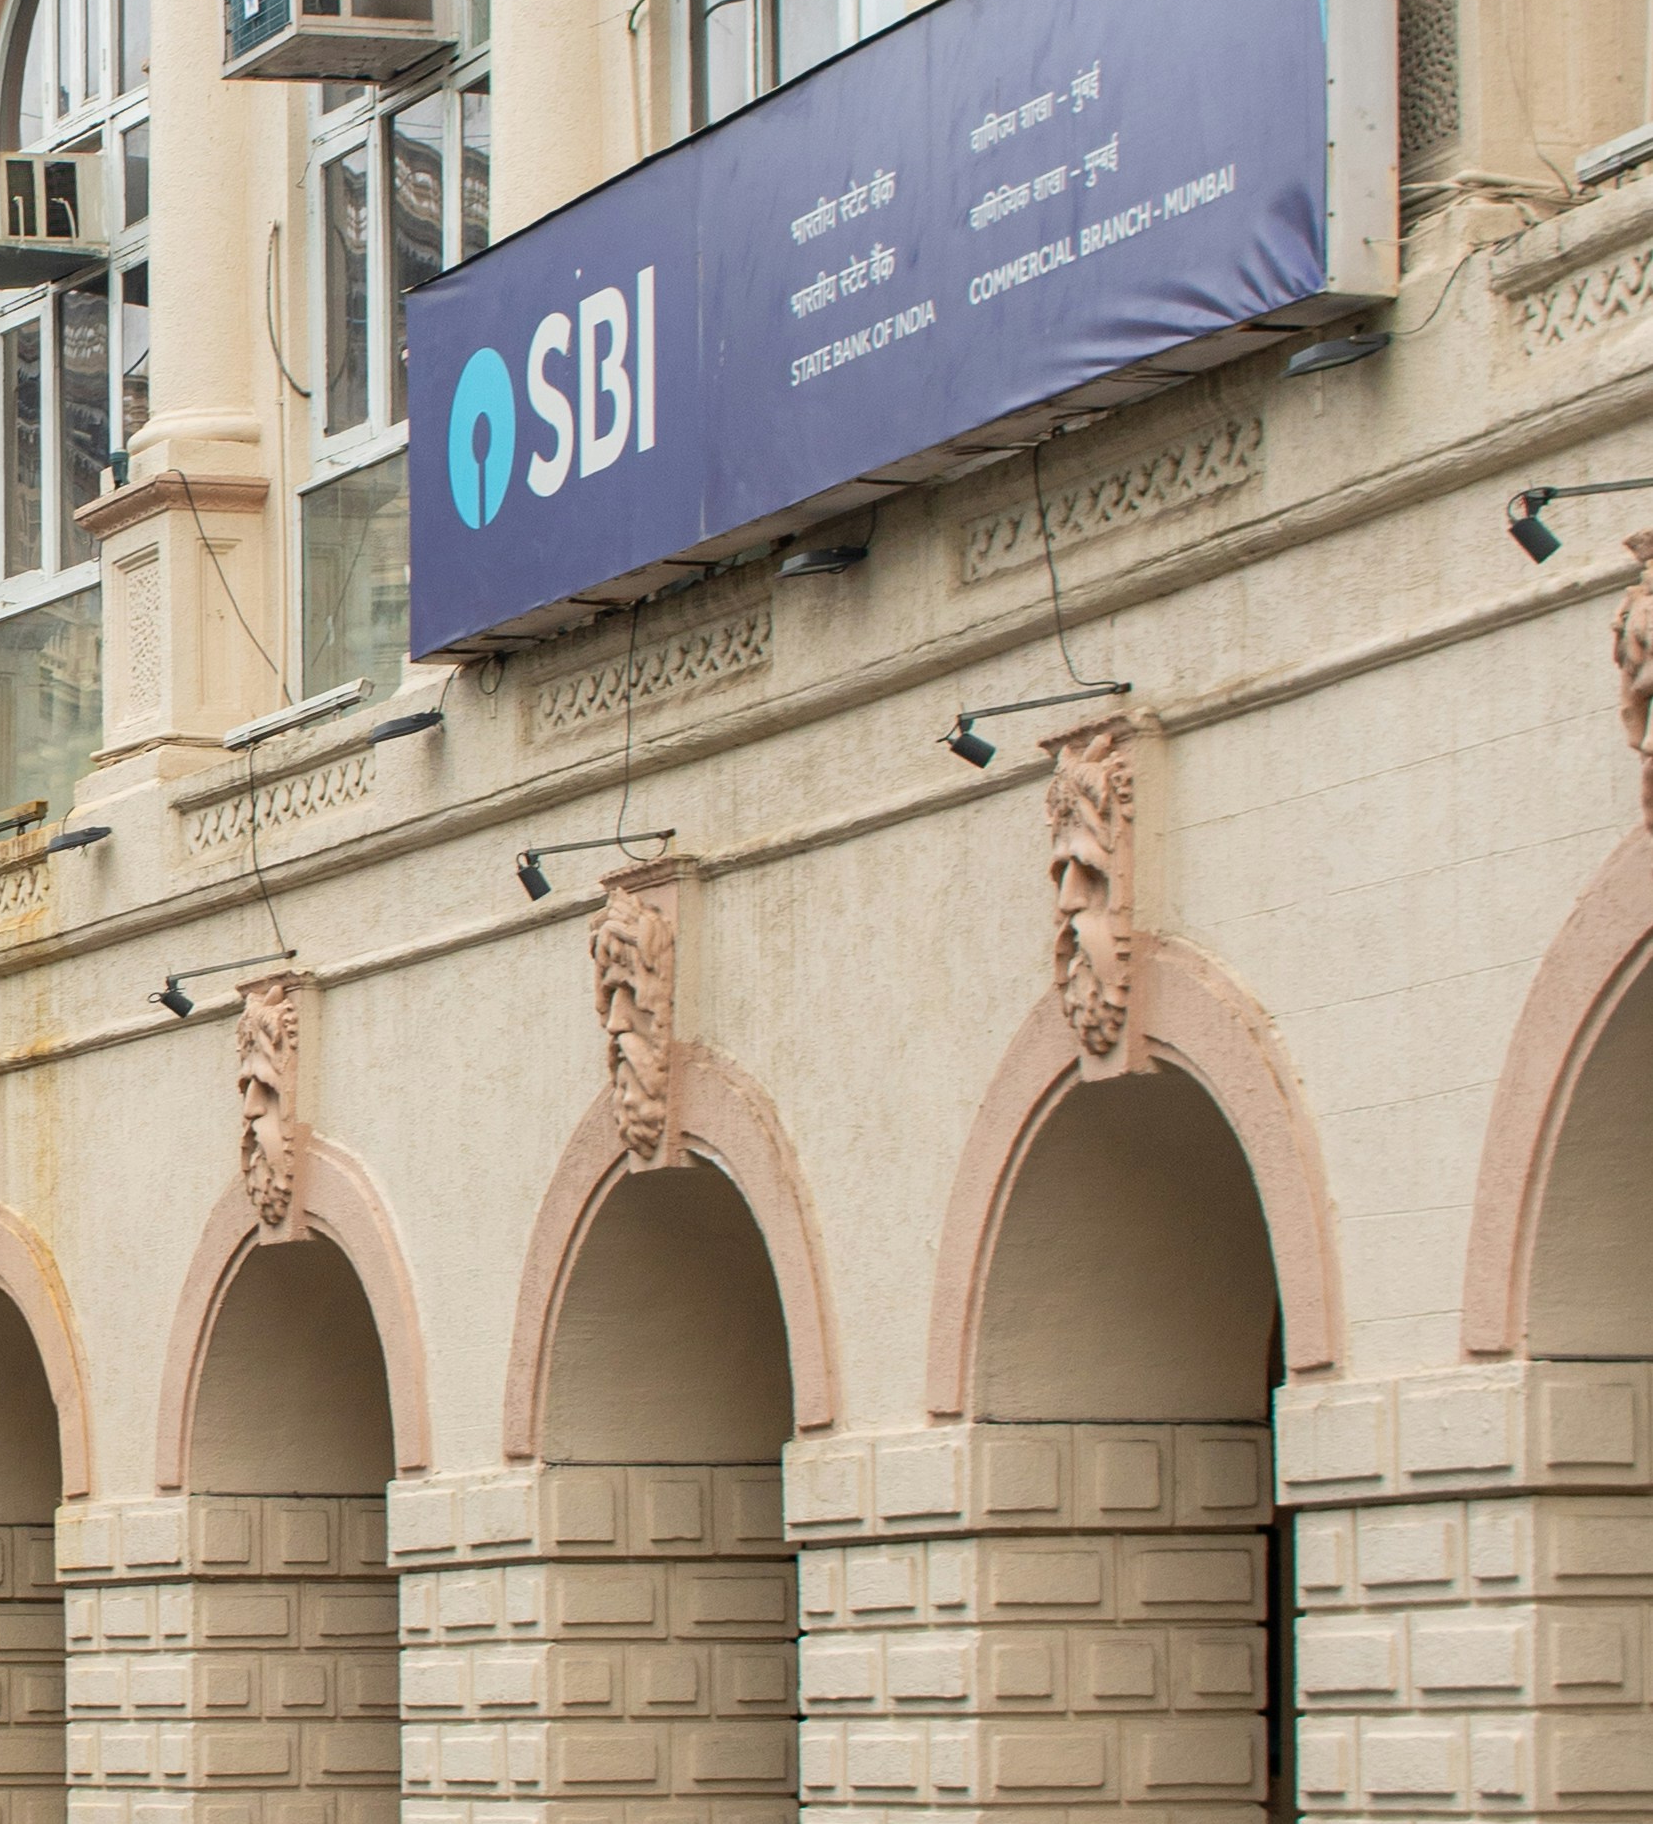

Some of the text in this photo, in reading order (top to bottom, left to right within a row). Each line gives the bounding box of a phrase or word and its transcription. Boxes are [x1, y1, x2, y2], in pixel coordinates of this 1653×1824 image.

[1019, 91, 1054, 129] शाखा
[1070, 59, 1100, 113] मुंबई
[790, 196, 838, 245] भारतीय
[839, 180, 869, 223] स्टेट
[1032, 165, 1068, 201] शाखा
[969, 236, 1077, 305] COMMERCIAL
[1080, 200, 1152, 257] BRANCH
[1164, 163, 1236, 221] MUMBAI
[790, 270, 838, 319] भारतीय
[838, 254, 869, 297] स्टेट
[791, 299, 937, 387] STATE BANK OF INDIA
[527, 265, 655, 498] SBI
